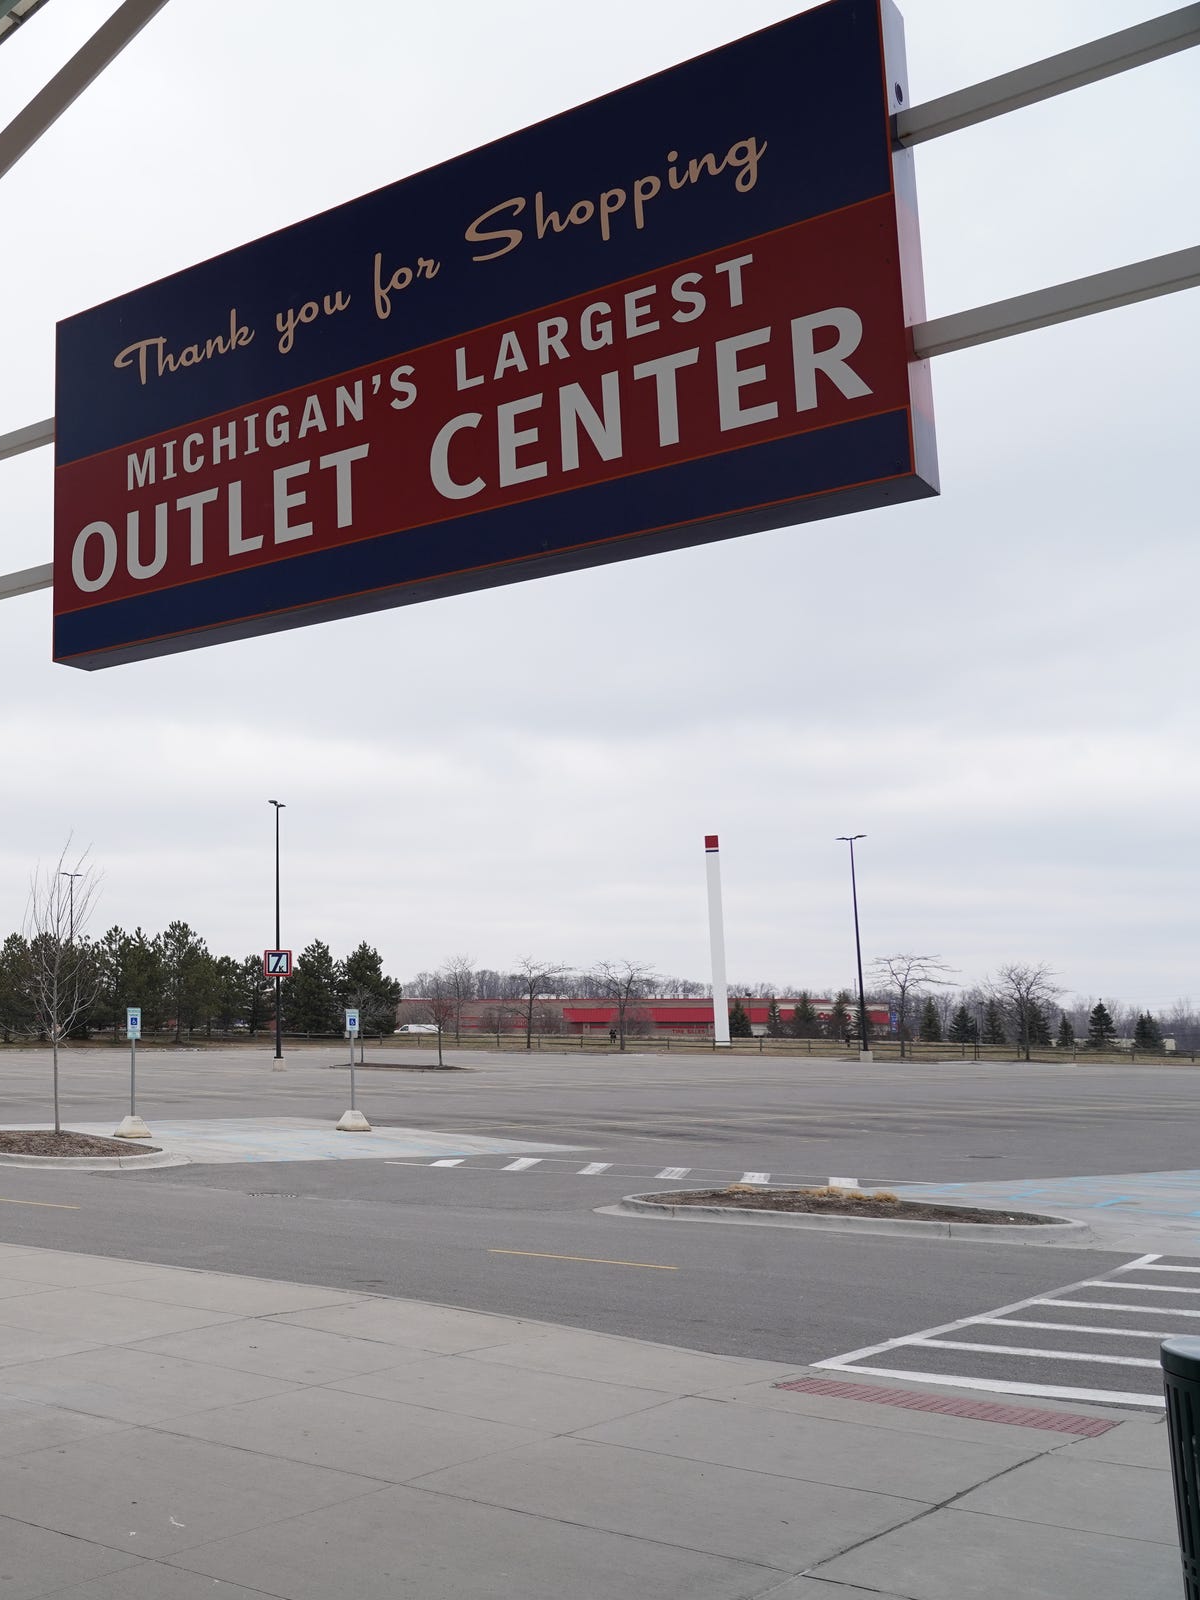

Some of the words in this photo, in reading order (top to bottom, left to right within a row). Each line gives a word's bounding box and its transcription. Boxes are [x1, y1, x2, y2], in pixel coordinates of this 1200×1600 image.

[113, 308, 255, 386] Thank
[276, 287, 351, 354] you
[373, 252, 441, 320] for
[464, 136, 768, 262] Shopping
[126, 364, 419, 492] MICHIGAN'S
[455, 253, 754, 393] LARGEST
[71, 442, 371, 594] OUTLET
[429, 306, 875, 501] CENTER
